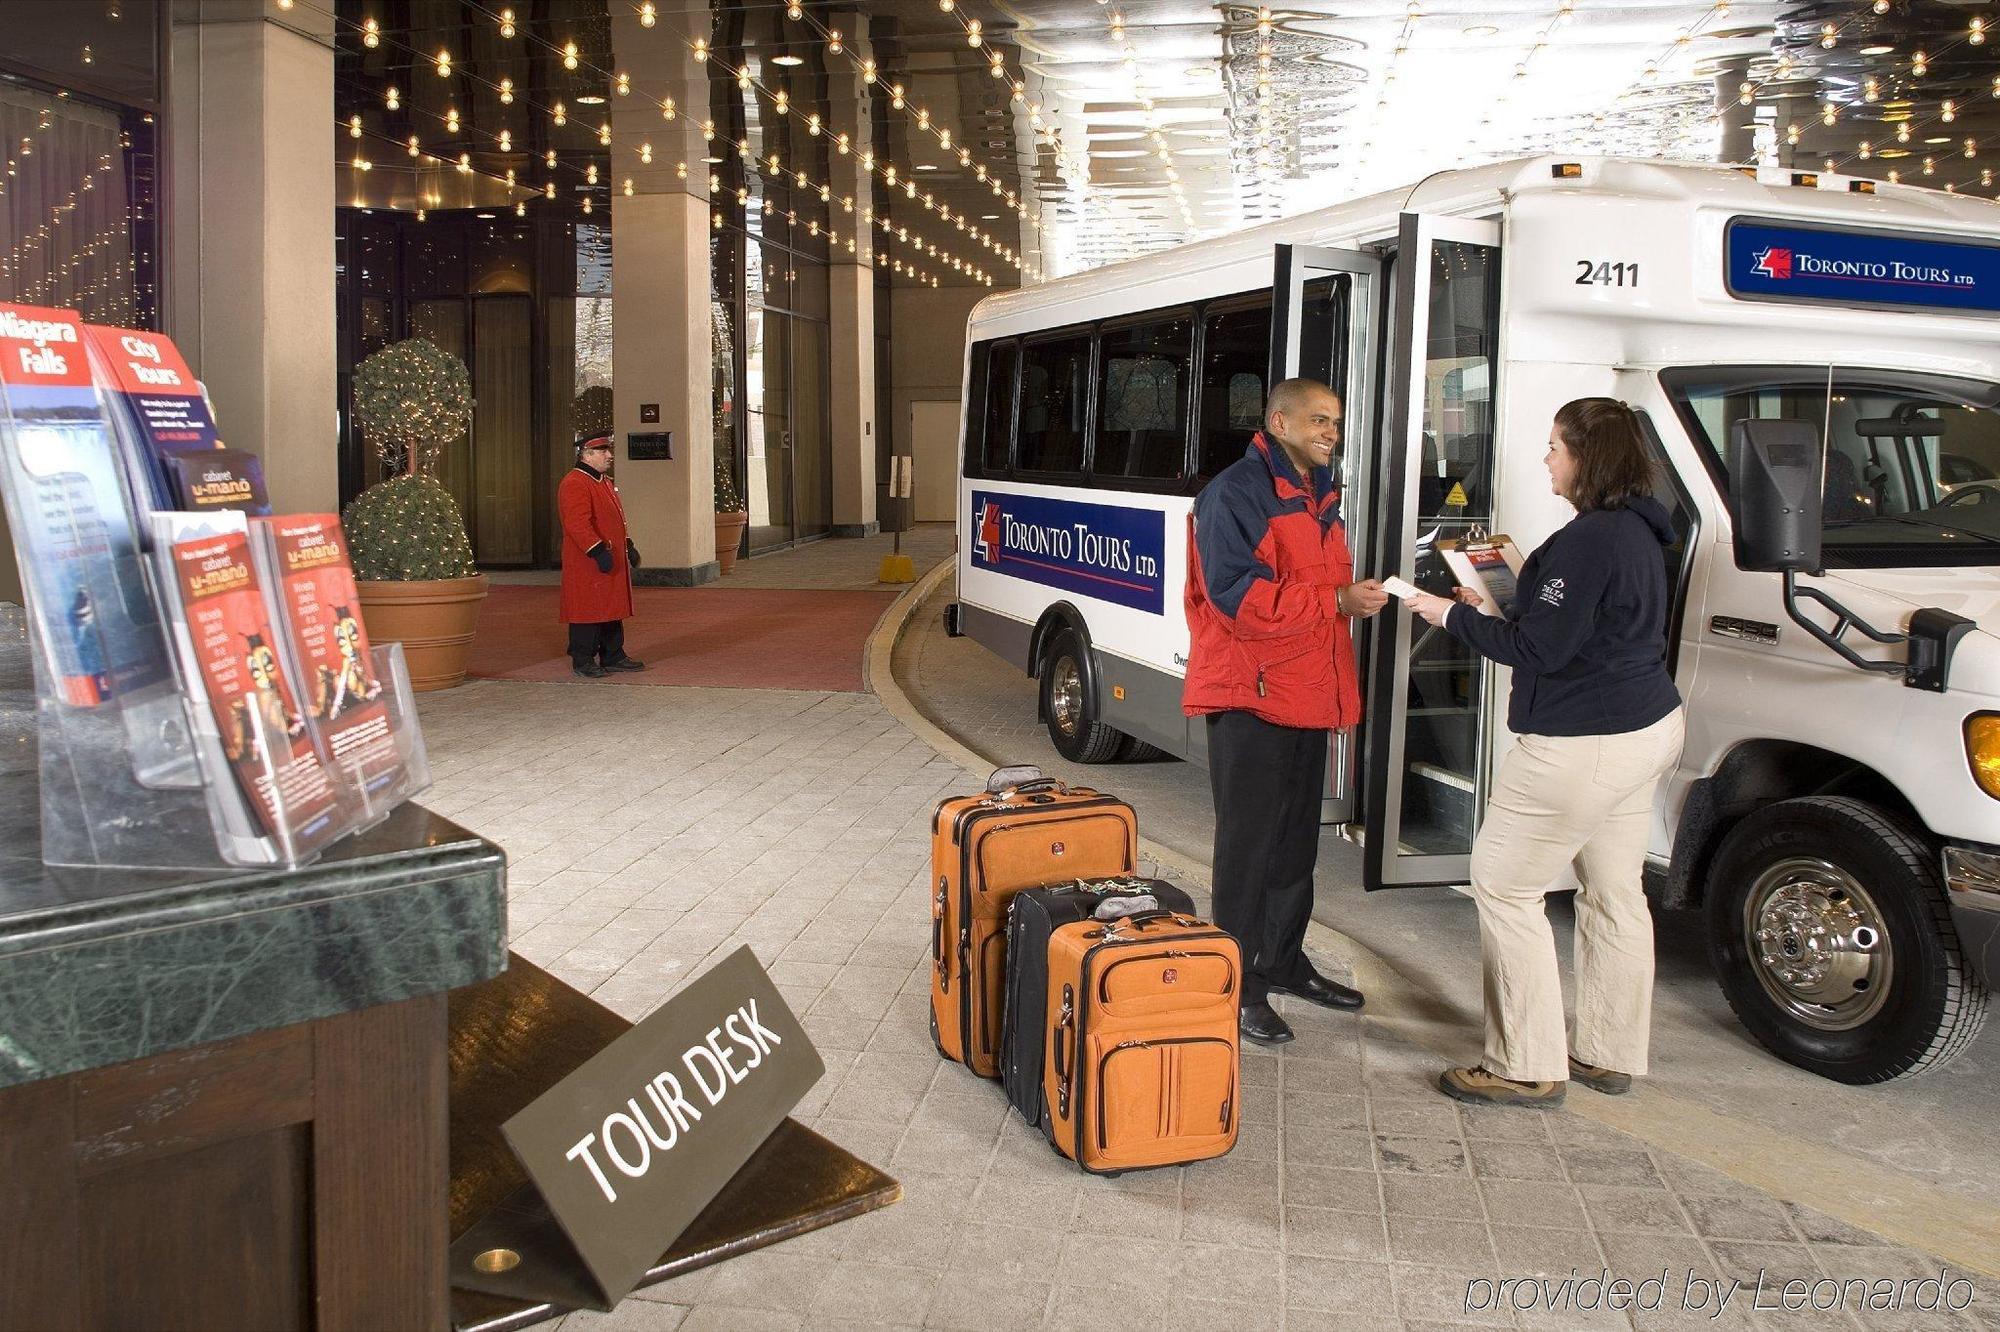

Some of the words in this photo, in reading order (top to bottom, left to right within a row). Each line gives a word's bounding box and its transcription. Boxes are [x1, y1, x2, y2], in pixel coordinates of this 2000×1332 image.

[1575, 260, 1638, 288] 2411
[1796, 254, 1886, 278] TORONTO
[1890, 262, 1950, 283] TOURS
[1954, 274, 1976, 286] LTD.
[0, 310, 78, 348] Niagara
[19, 347, 68, 376] Falls
[121, 335, 161, 364] City
[128, 361, 182, 386] Tours
[1002, 513, 1071, 559] TORONTO
[1074, 524, 1131, 572] TOURS
[1136, 555, 1158, 577] LTD.
[565, 1071, 702, 1203] TOUR
[681, 998, 782, 1106] DESK
